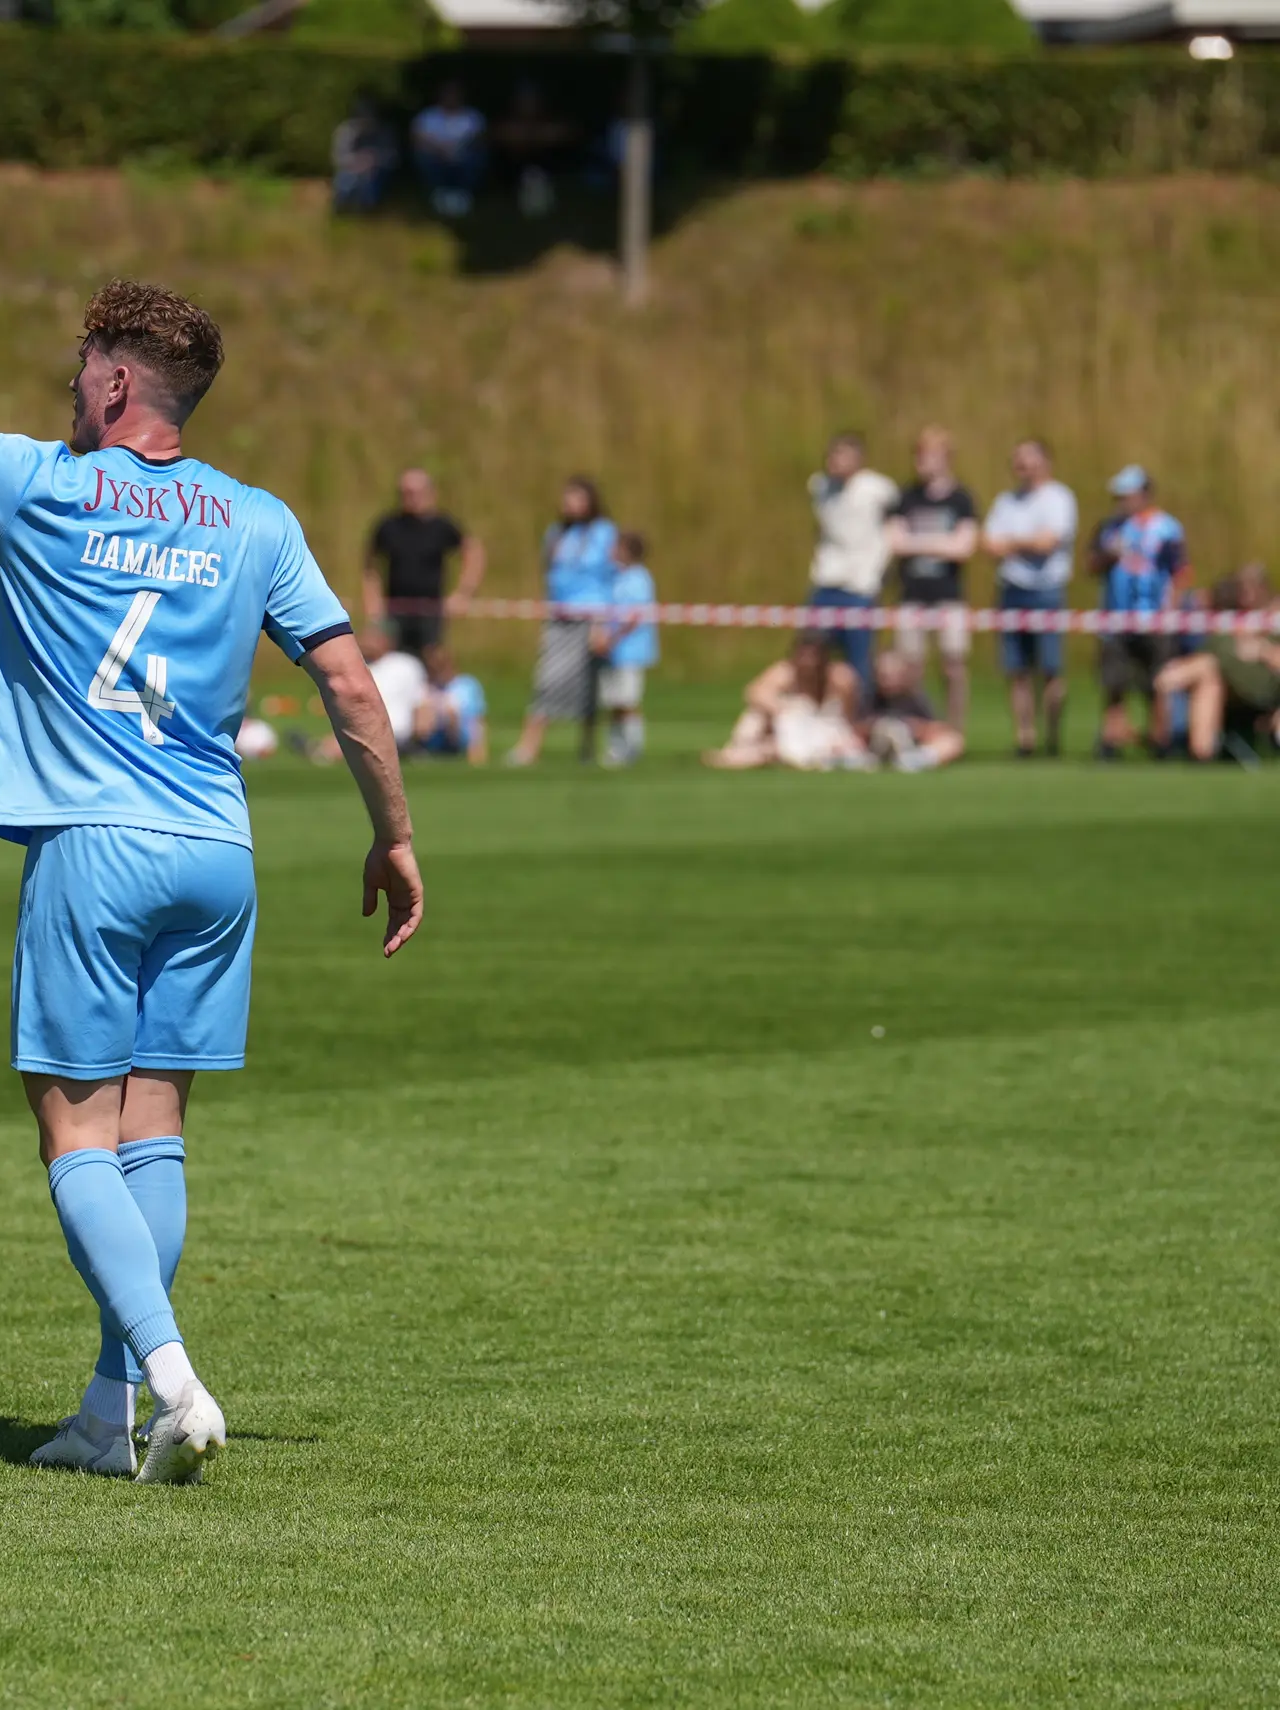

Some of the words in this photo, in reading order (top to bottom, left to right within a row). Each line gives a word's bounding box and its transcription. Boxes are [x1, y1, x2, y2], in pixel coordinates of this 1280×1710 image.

[84, 466, 170, 522] JYSK
[172, 480, 232, 528] VIN
[80, 529, 221, 587] DAMMERS
[87, 590, 176, 745] 4
